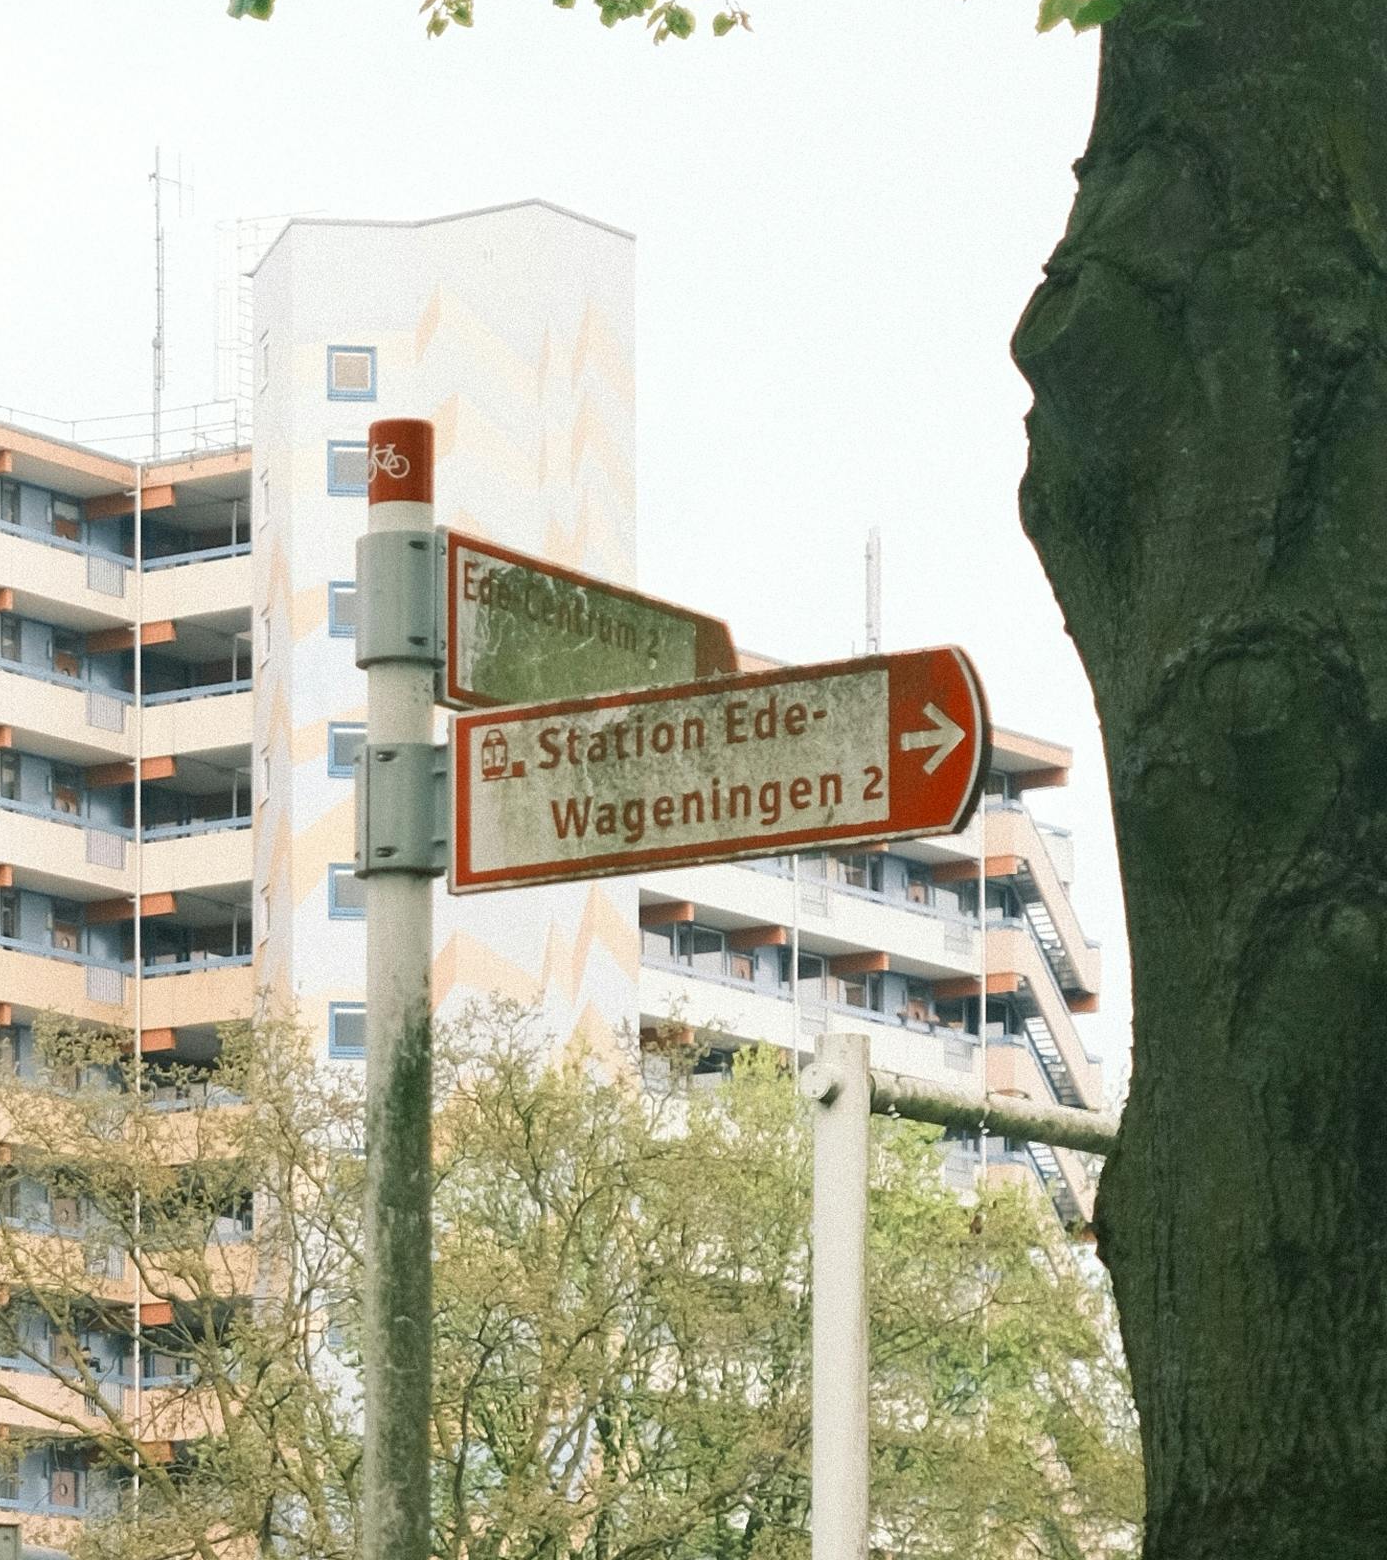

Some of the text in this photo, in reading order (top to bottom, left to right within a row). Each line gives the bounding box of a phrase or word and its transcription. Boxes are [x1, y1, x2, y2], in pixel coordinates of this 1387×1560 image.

[538, 696, 828, 770] Station Ede-
[550, 765, 884, 845] Wageningen 2
